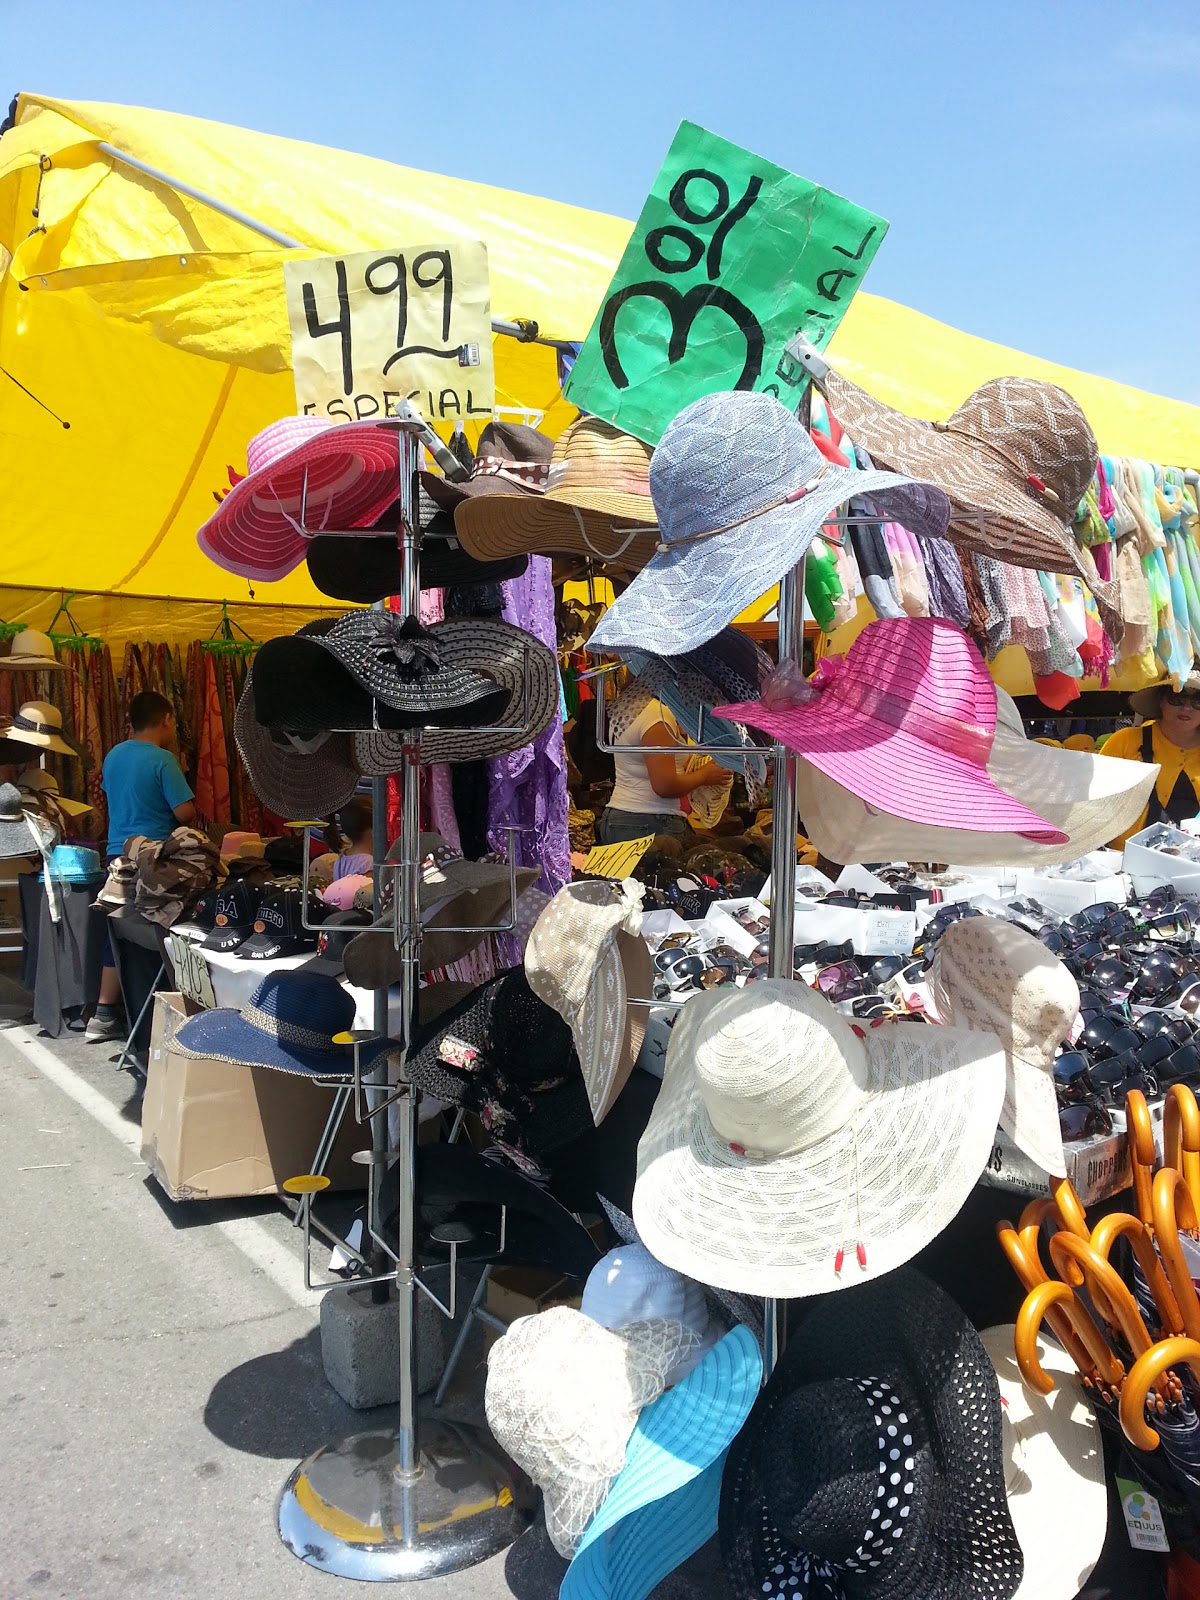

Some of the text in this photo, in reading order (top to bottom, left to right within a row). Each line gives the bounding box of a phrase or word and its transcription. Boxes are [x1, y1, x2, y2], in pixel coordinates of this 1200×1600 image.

[763, 225, 877, 400] PECIAL
[215, 898, 239, 919] SA
[221, 937, 241, 948] USA
[251, 944, 281, 959] SAN DIEGO
[1127, 1520, 1163, 1531] EQUUS
